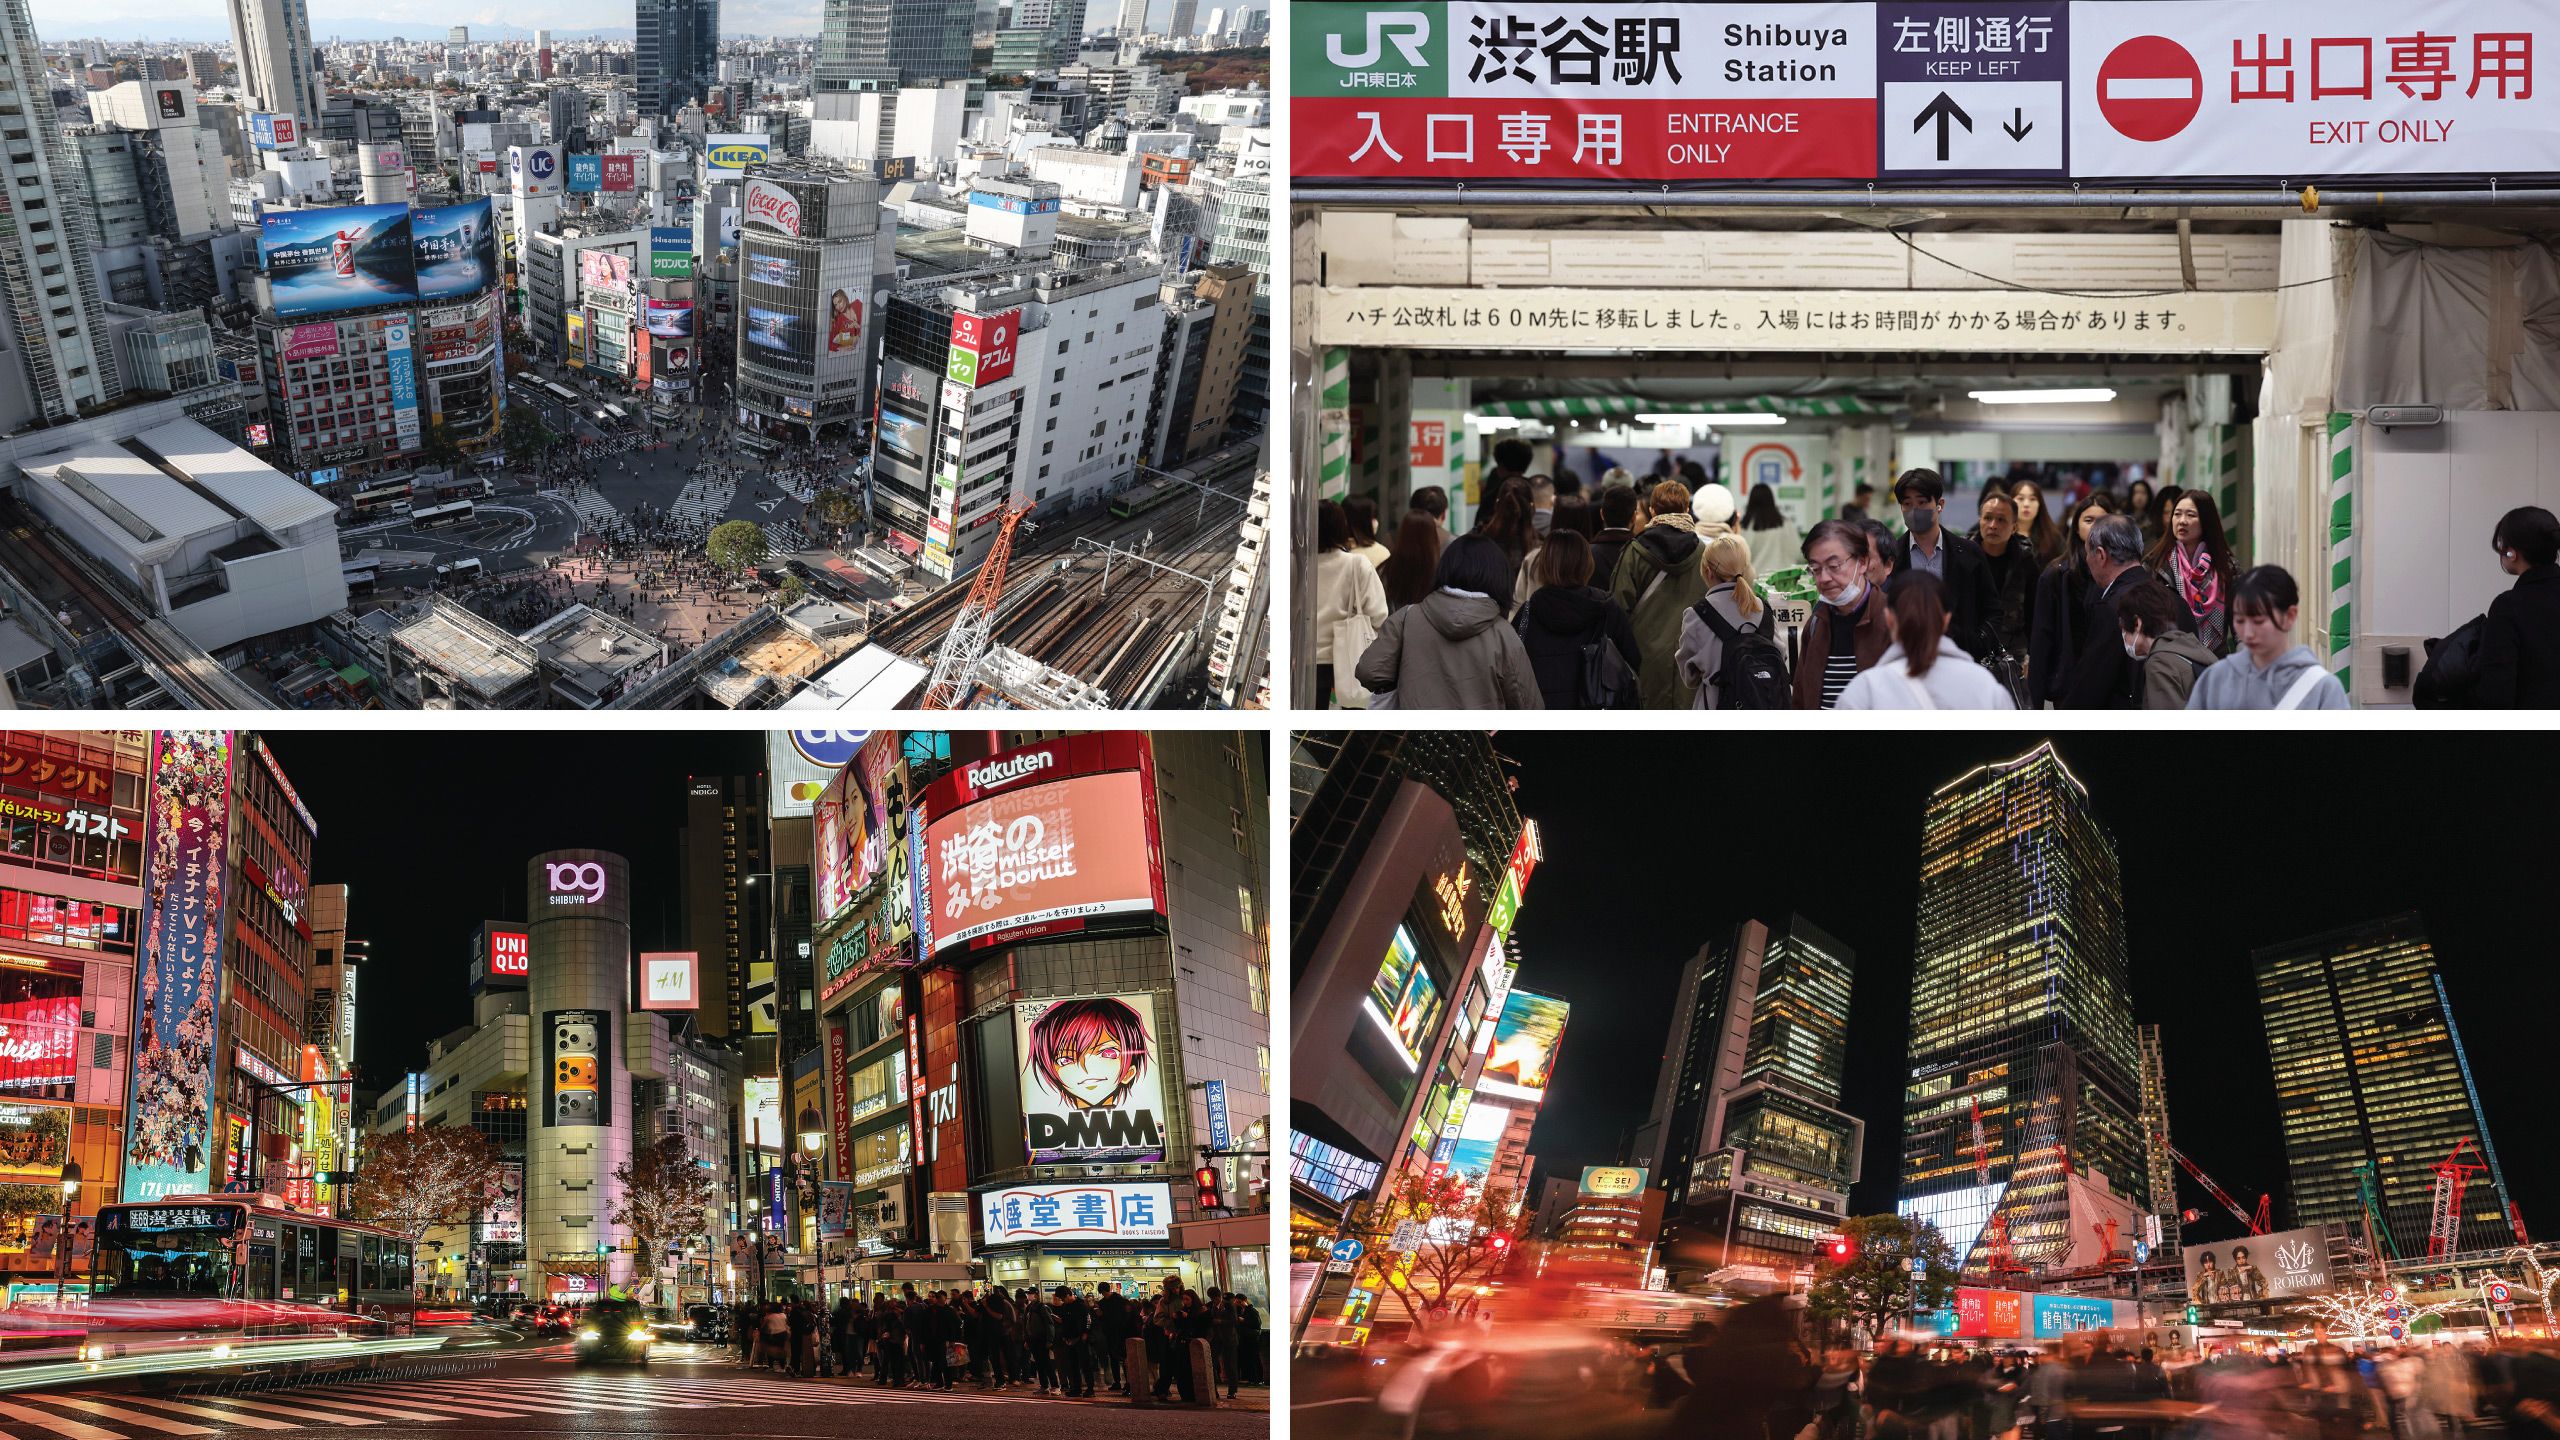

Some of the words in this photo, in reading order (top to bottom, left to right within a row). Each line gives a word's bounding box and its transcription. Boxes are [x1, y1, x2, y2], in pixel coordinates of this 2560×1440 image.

[1326, 11, 1430, 68] JR
[1724, 24, 1848, 53] Shibuya
[1892, 15, 2053, 54] 左側通行
[1467, 15, 1682, 86] 渋谷駅
[1724, 59, 1837, 82] Station
[1926, 60, 1972, 76] KEEP
[1978, 60, 2021, 76] LEFT
[2231, 31, 2533, 104] 出口専用
[1340, 72, 1417, 89] JR東日本
[276, 123, 290, 131] UNI
[1667, 113, 1799, 134] ENTRANCE
[2309, 122, 2366, 144] EXIT
[2378, 119, 2455, 144] ONLY
[277, 131, 292, 140] QLO
[1348, 111, 1623, 166] 入口専用
[713, 151, 763, 162] IKEA
[1667, 143, 1732, 165] ONLY
[1243, 159, 1270, 169] MO
[653, 258, 689, 269] サロンパス
[955, 330, 977, 345] アコム
[445, 348, 465, 359] ガスト
[981, 346, 1011, 372] アコム
[669, 366, 688, 375] DMM
[323, 448, 364, 462] サンドラッグ
[1772, 608, 1804, 622] 通行
[968, 751, 1053, 789] Rakuten
[690, 788, 719, 796] INDIGO
[65, 810, 129, 840] ガスト
[999, 842, 1074, 870] mister
[546, 862, 605, 904] 109
[1000, 861, 1077, 888] Donut
[550, 895, 585, 905] SHIBUYA
[997, 930, 1025, 942] Rakuten
[1024, 925, 1047, 935] Vision
[496, 937, 526, 953] UNI
[496, 954, 528, 972] QLO
[1028, 1109, 1162, 1150] DMM
[149, 1214, 212, 1225] 渋谷駅
[988, 1193, 1154, 1233] 大盛堂書店
[2273, 1272, 2326, 1290] ROIROM
